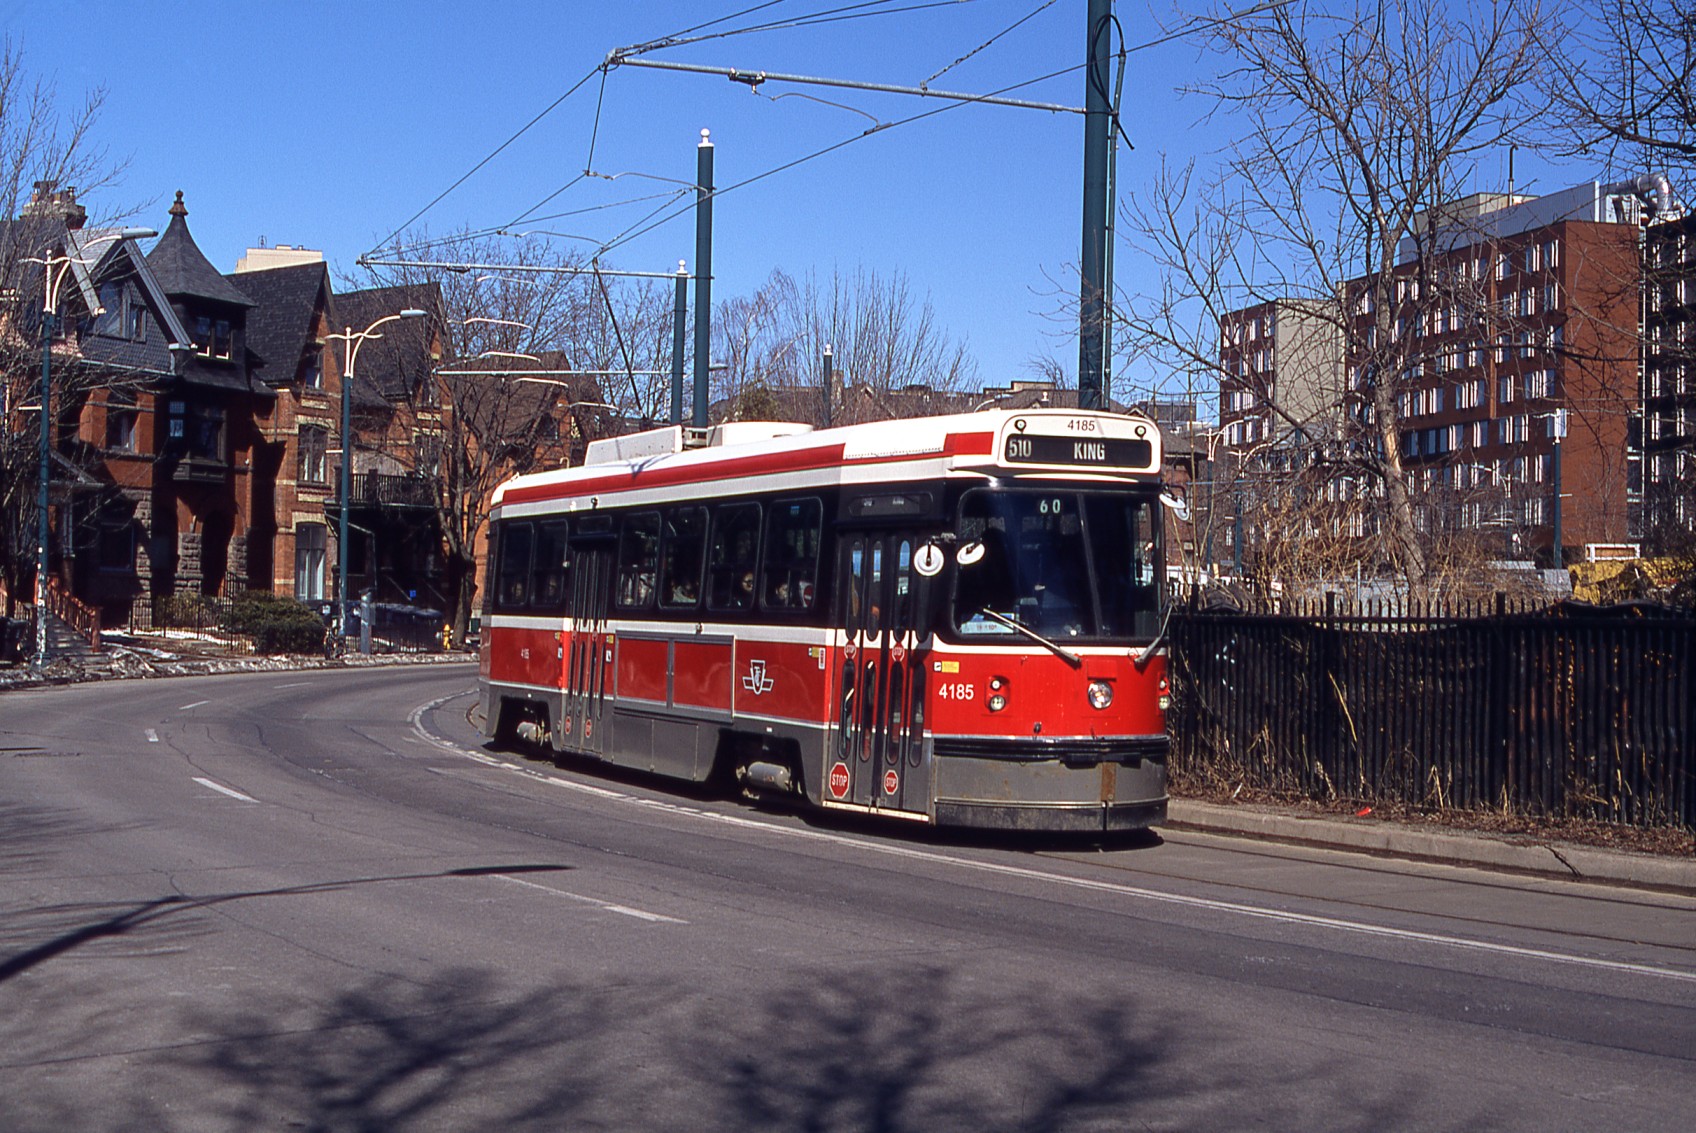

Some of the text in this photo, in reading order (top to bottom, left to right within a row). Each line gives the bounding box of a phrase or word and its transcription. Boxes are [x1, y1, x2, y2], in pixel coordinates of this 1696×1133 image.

[1067, 419, 1096, 432] 4185
[1009, 438, 1105, 461] 510 KING
[938, 682, 975, 700] 4185
[831, 773, 848, 787] STOP
